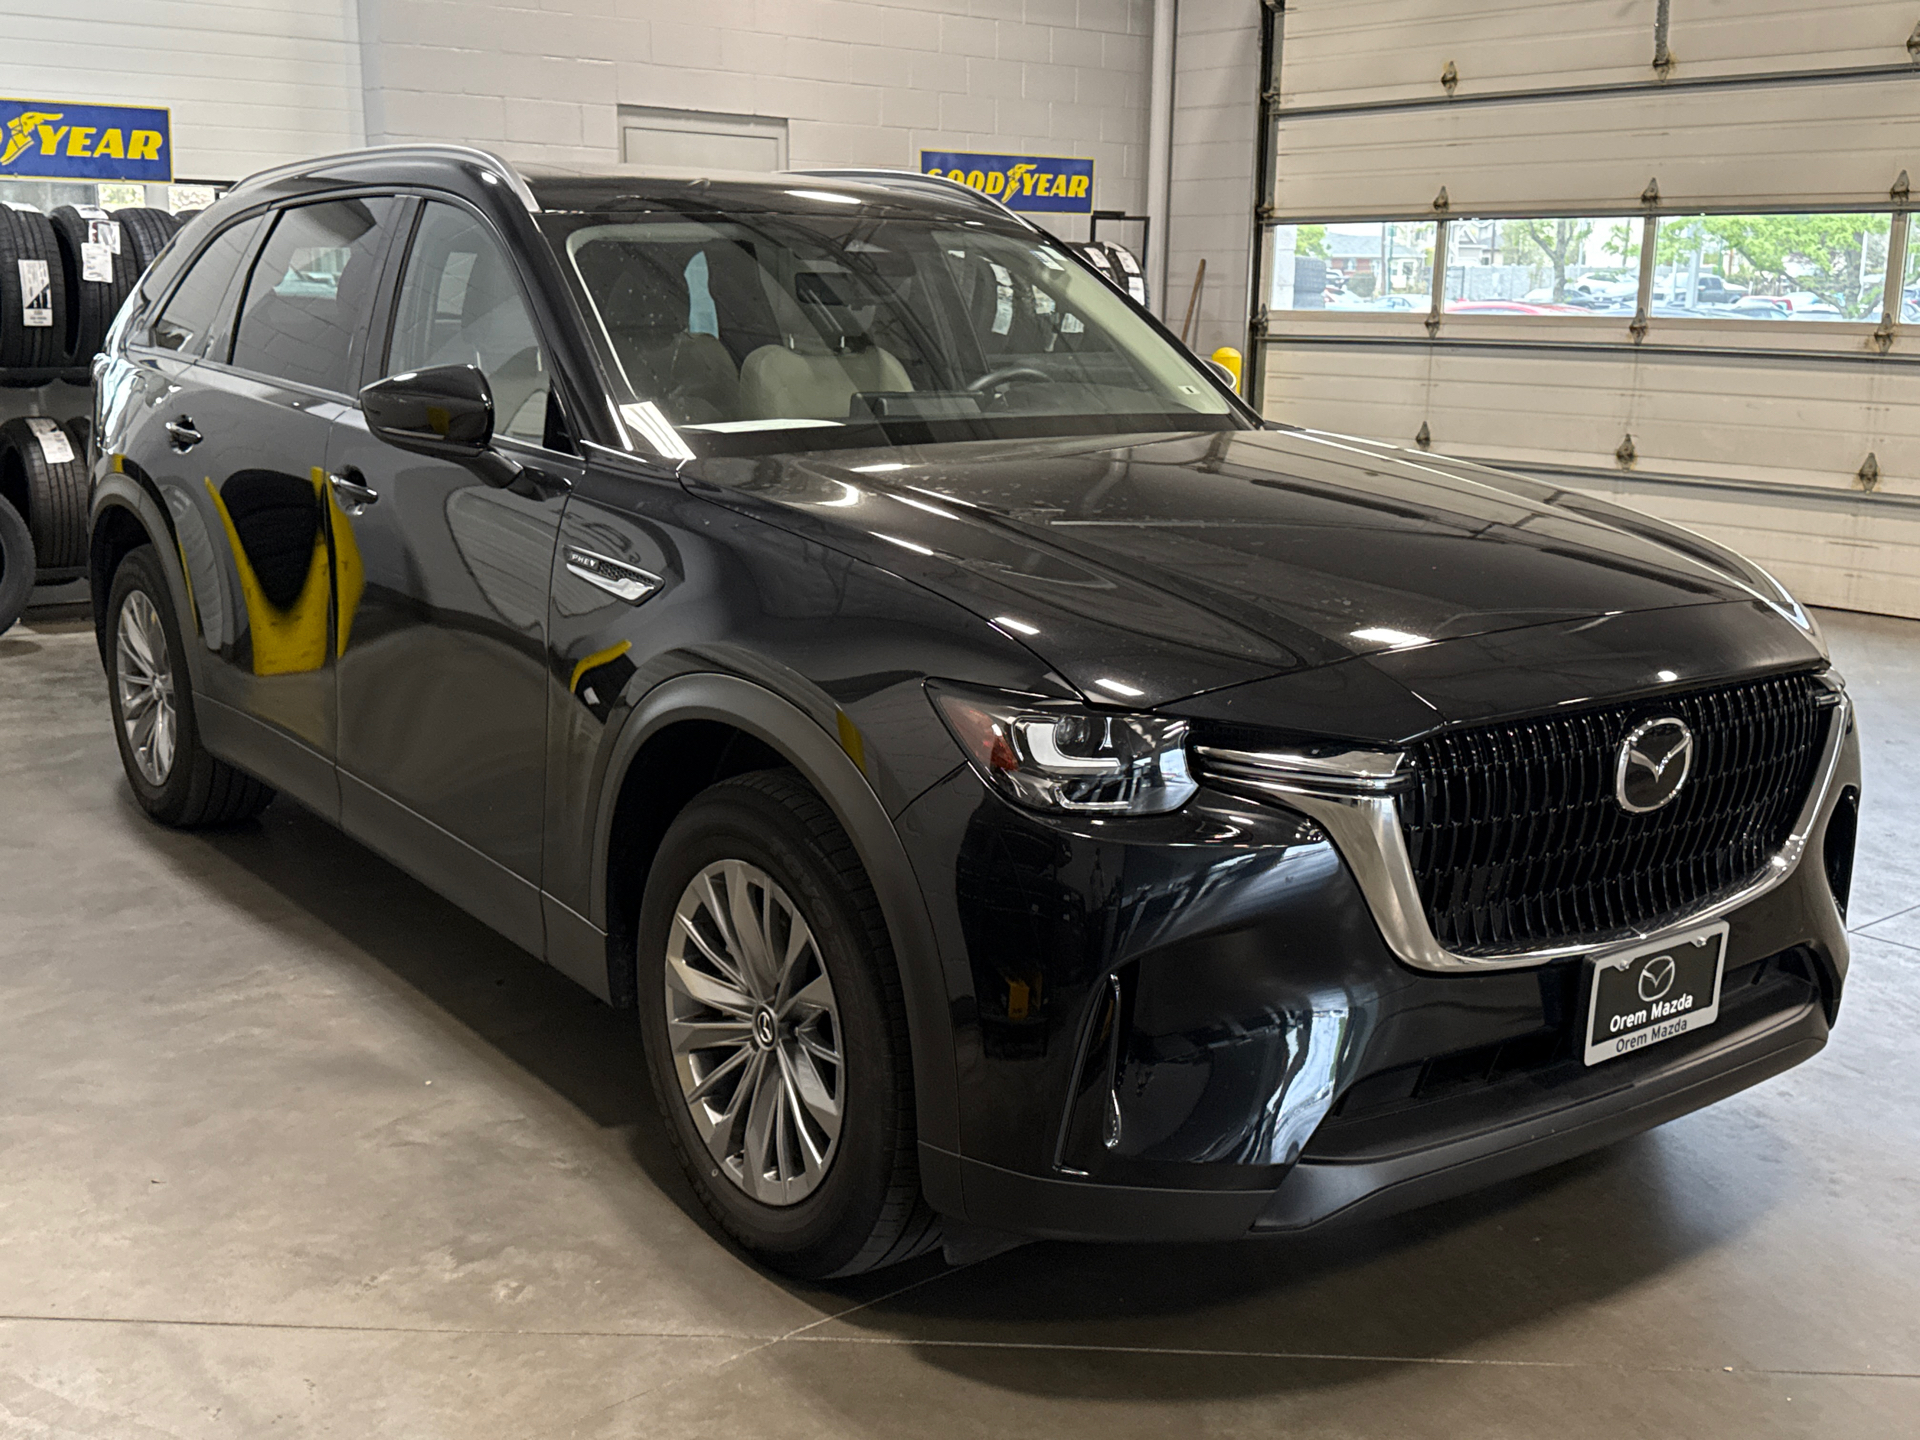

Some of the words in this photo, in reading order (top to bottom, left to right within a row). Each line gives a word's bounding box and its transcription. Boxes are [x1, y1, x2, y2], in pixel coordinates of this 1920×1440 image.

[0, 124, 163, 161] YEAR
[926, 168, 1089, 198] ODYEAR
[571, 553, 596, 567] PHEV
[1609, 1008, 1647, 1033] Orem
[1650, 993, 1693, 1020] Mazda
[1616, 1032, 1647, 1053] Orem
[1651, 1018, 1687, 1041] Mazda
